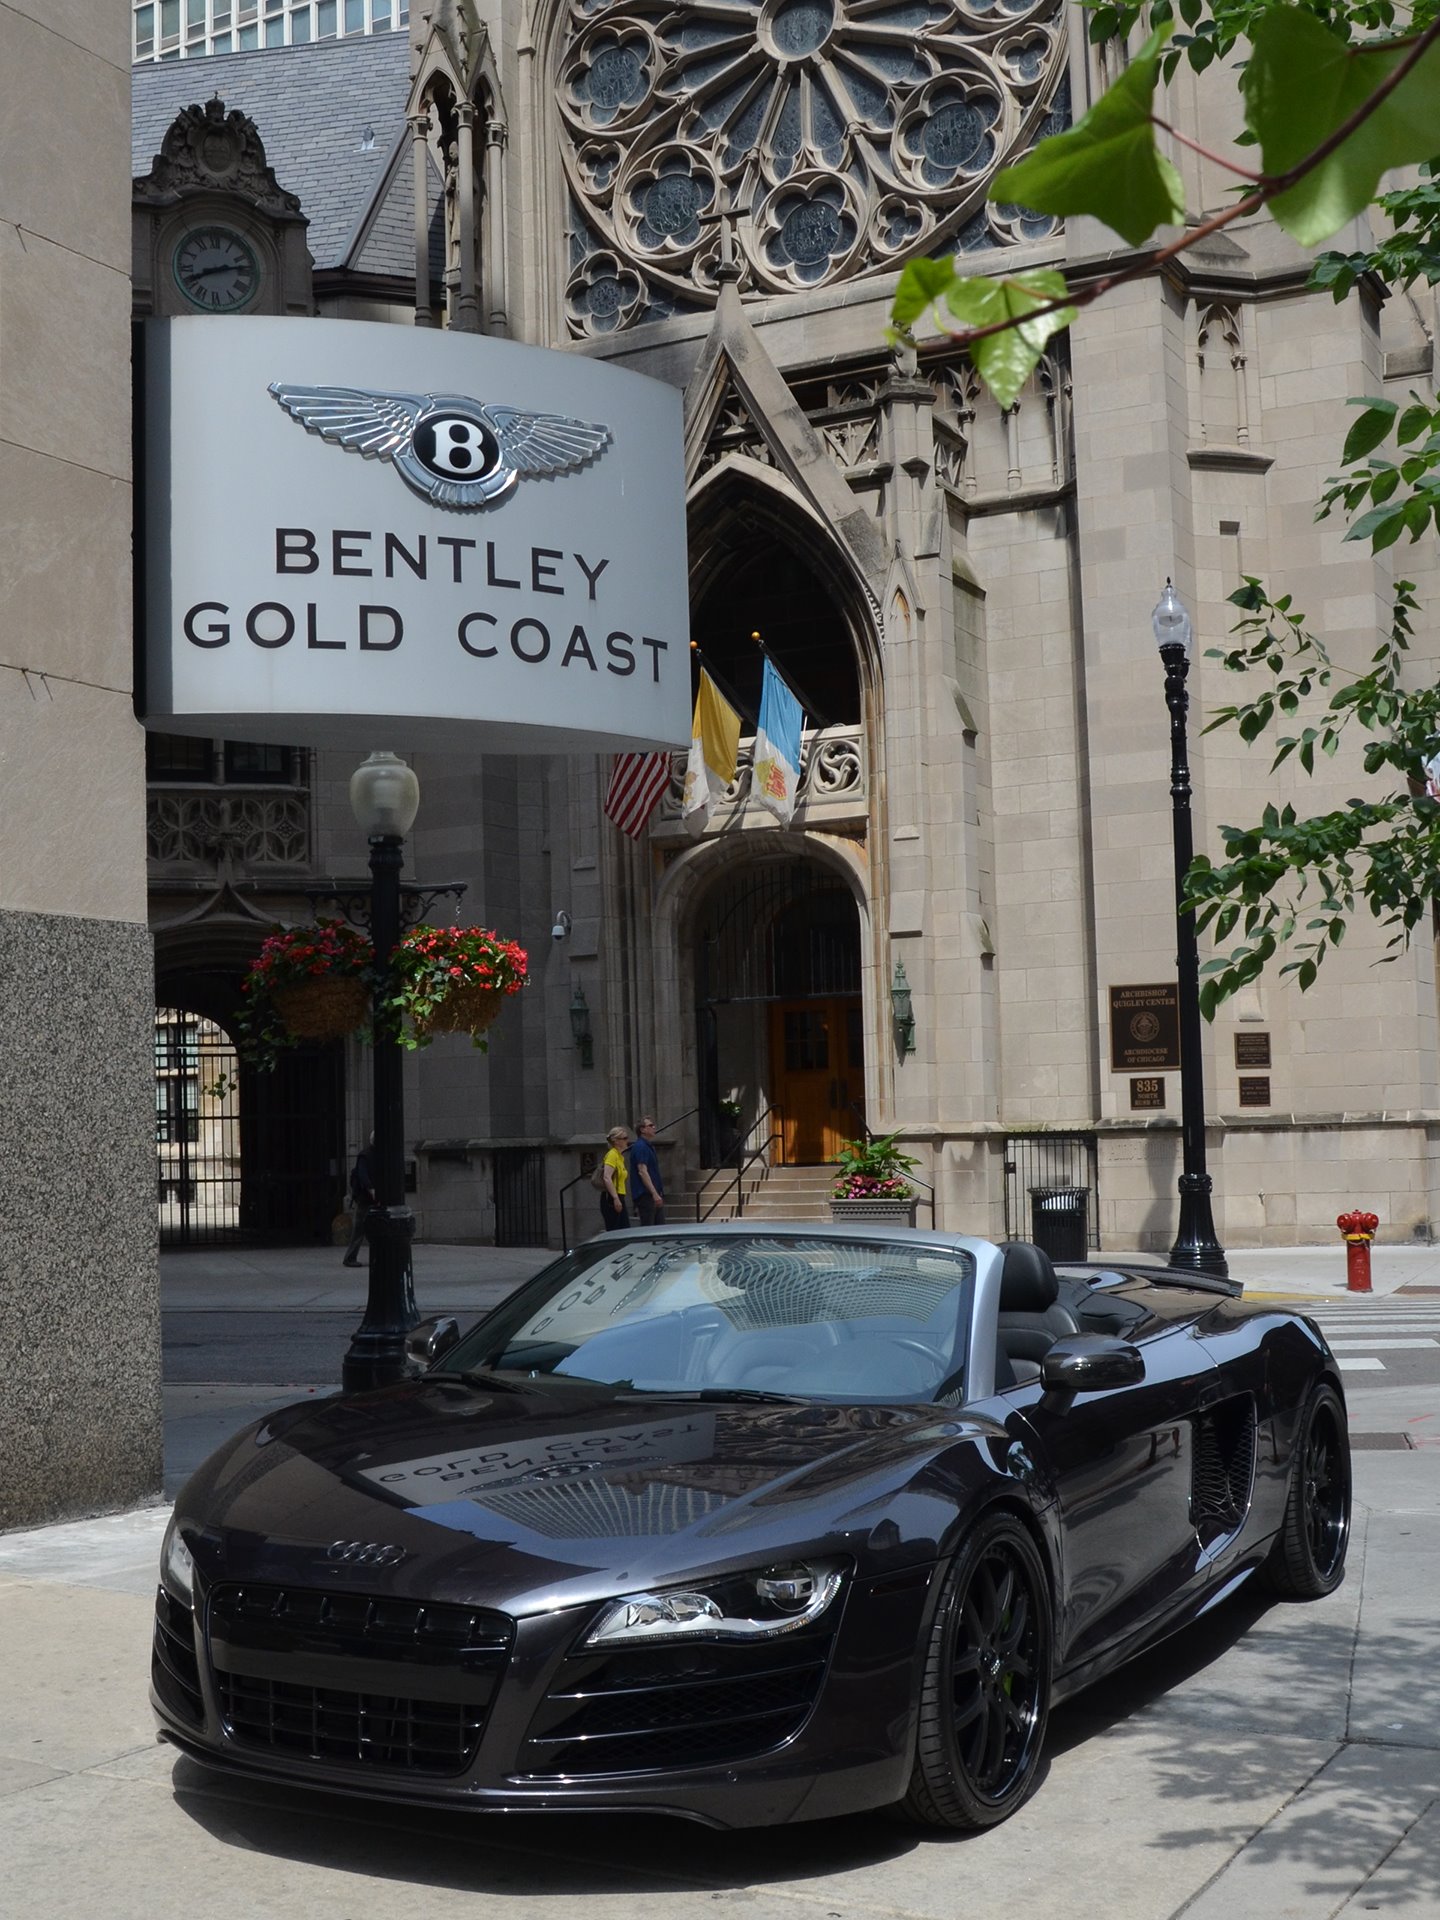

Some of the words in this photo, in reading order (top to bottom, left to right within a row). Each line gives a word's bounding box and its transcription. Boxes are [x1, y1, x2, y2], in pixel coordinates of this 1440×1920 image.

[431, 419, 485, 474] B
[275, 527, 610, 600] BENTLEY
[183, 601, 404, 651] GOLD
[458, 612, 668, 683] COAST
[1120, 989, 1168, 998] ARCHBISHOP
[1113, 1000, 1145, 1008] QUIGLEY
[1145, 998, 1176, 1006] CENTER
[1136, 1055, 1166, 1063] CHICAGO
[1136, 1079, 1159, 1092] 835
